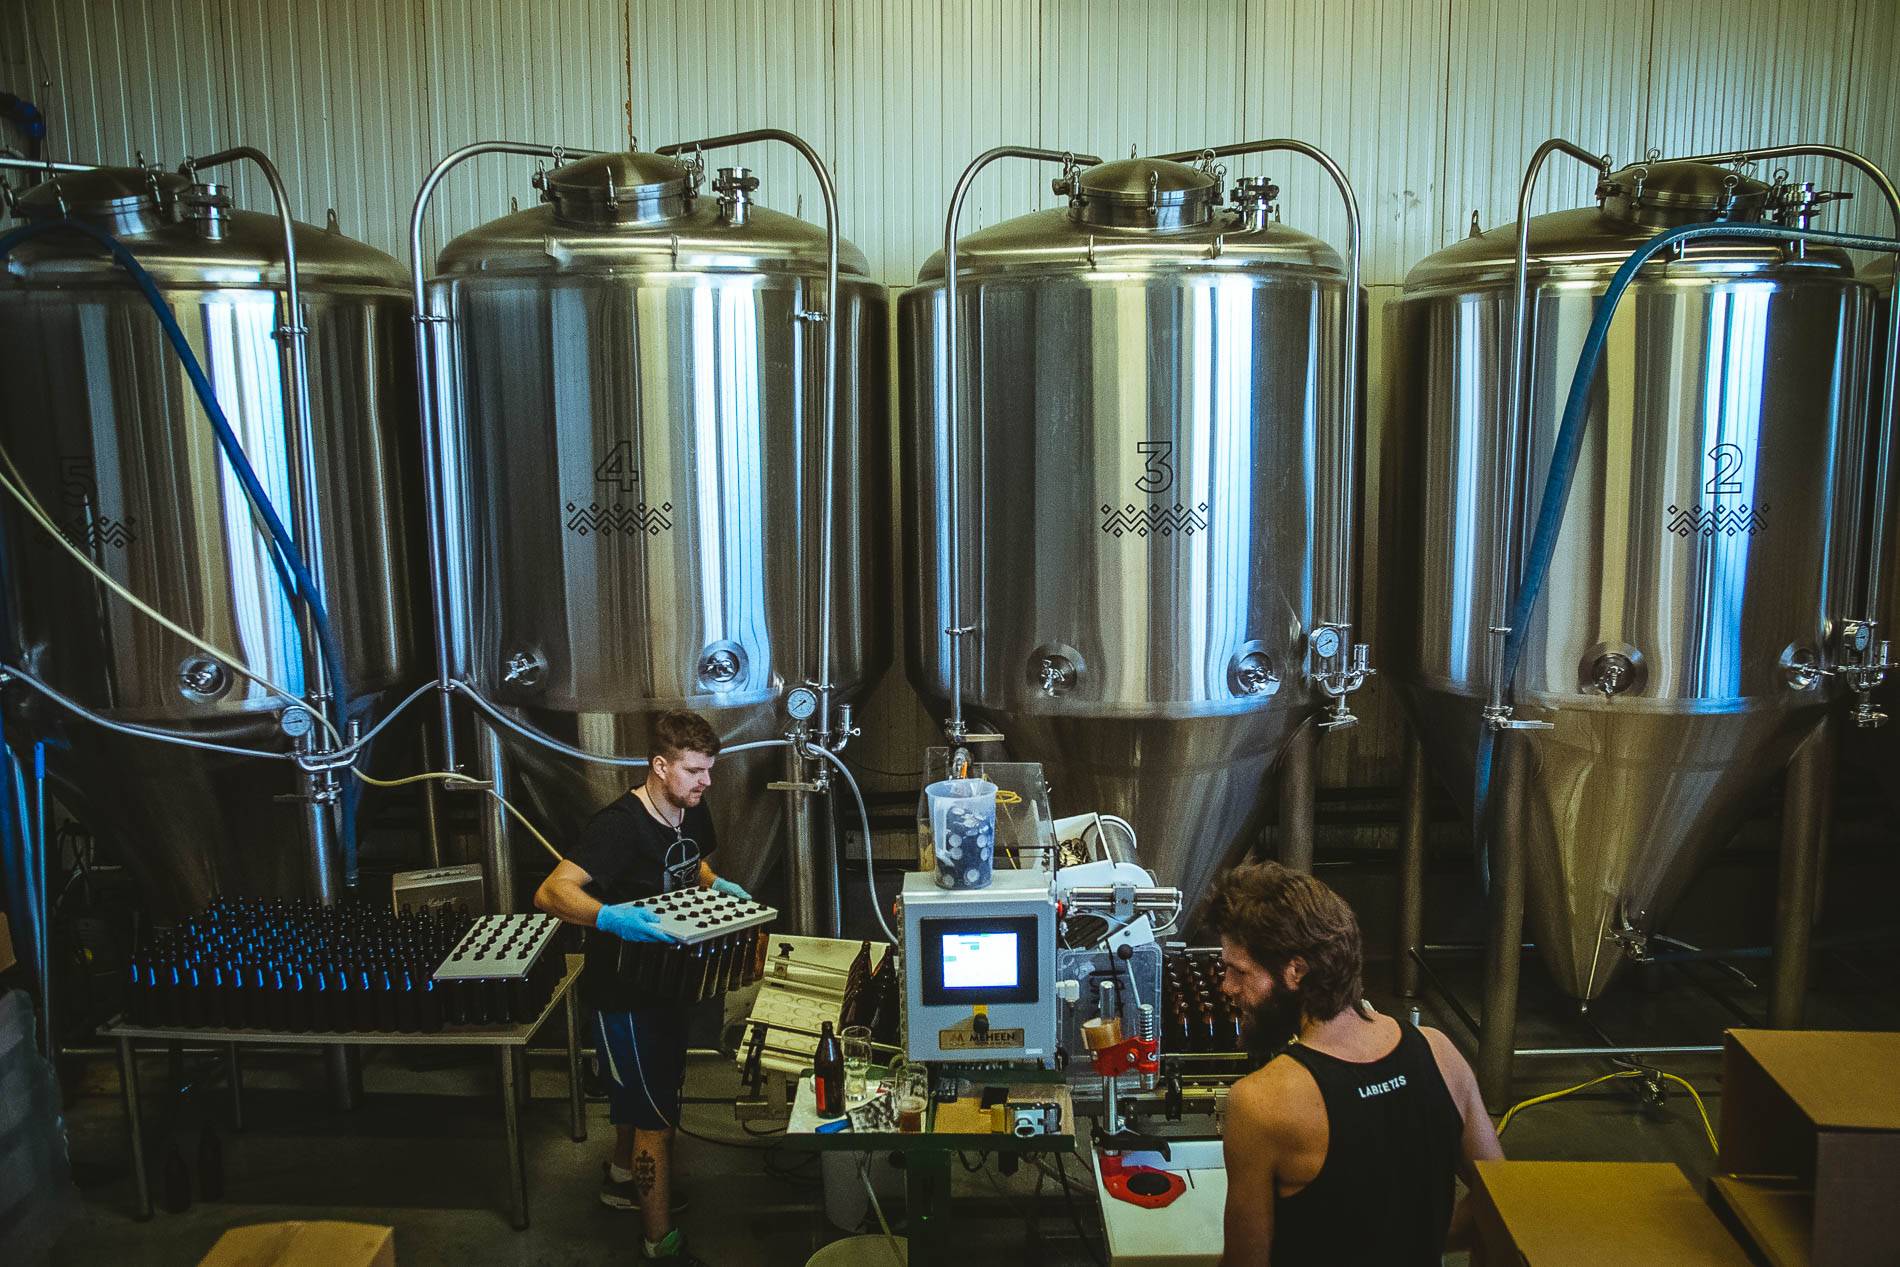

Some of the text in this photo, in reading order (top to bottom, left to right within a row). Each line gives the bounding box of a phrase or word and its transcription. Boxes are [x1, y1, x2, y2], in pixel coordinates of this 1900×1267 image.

[60, 456, 96, 508] 5
[595, 440, 639, 492] 4
[1134, 441, 1174, 494] 3
[1705, 443, 1743, 494] 2
